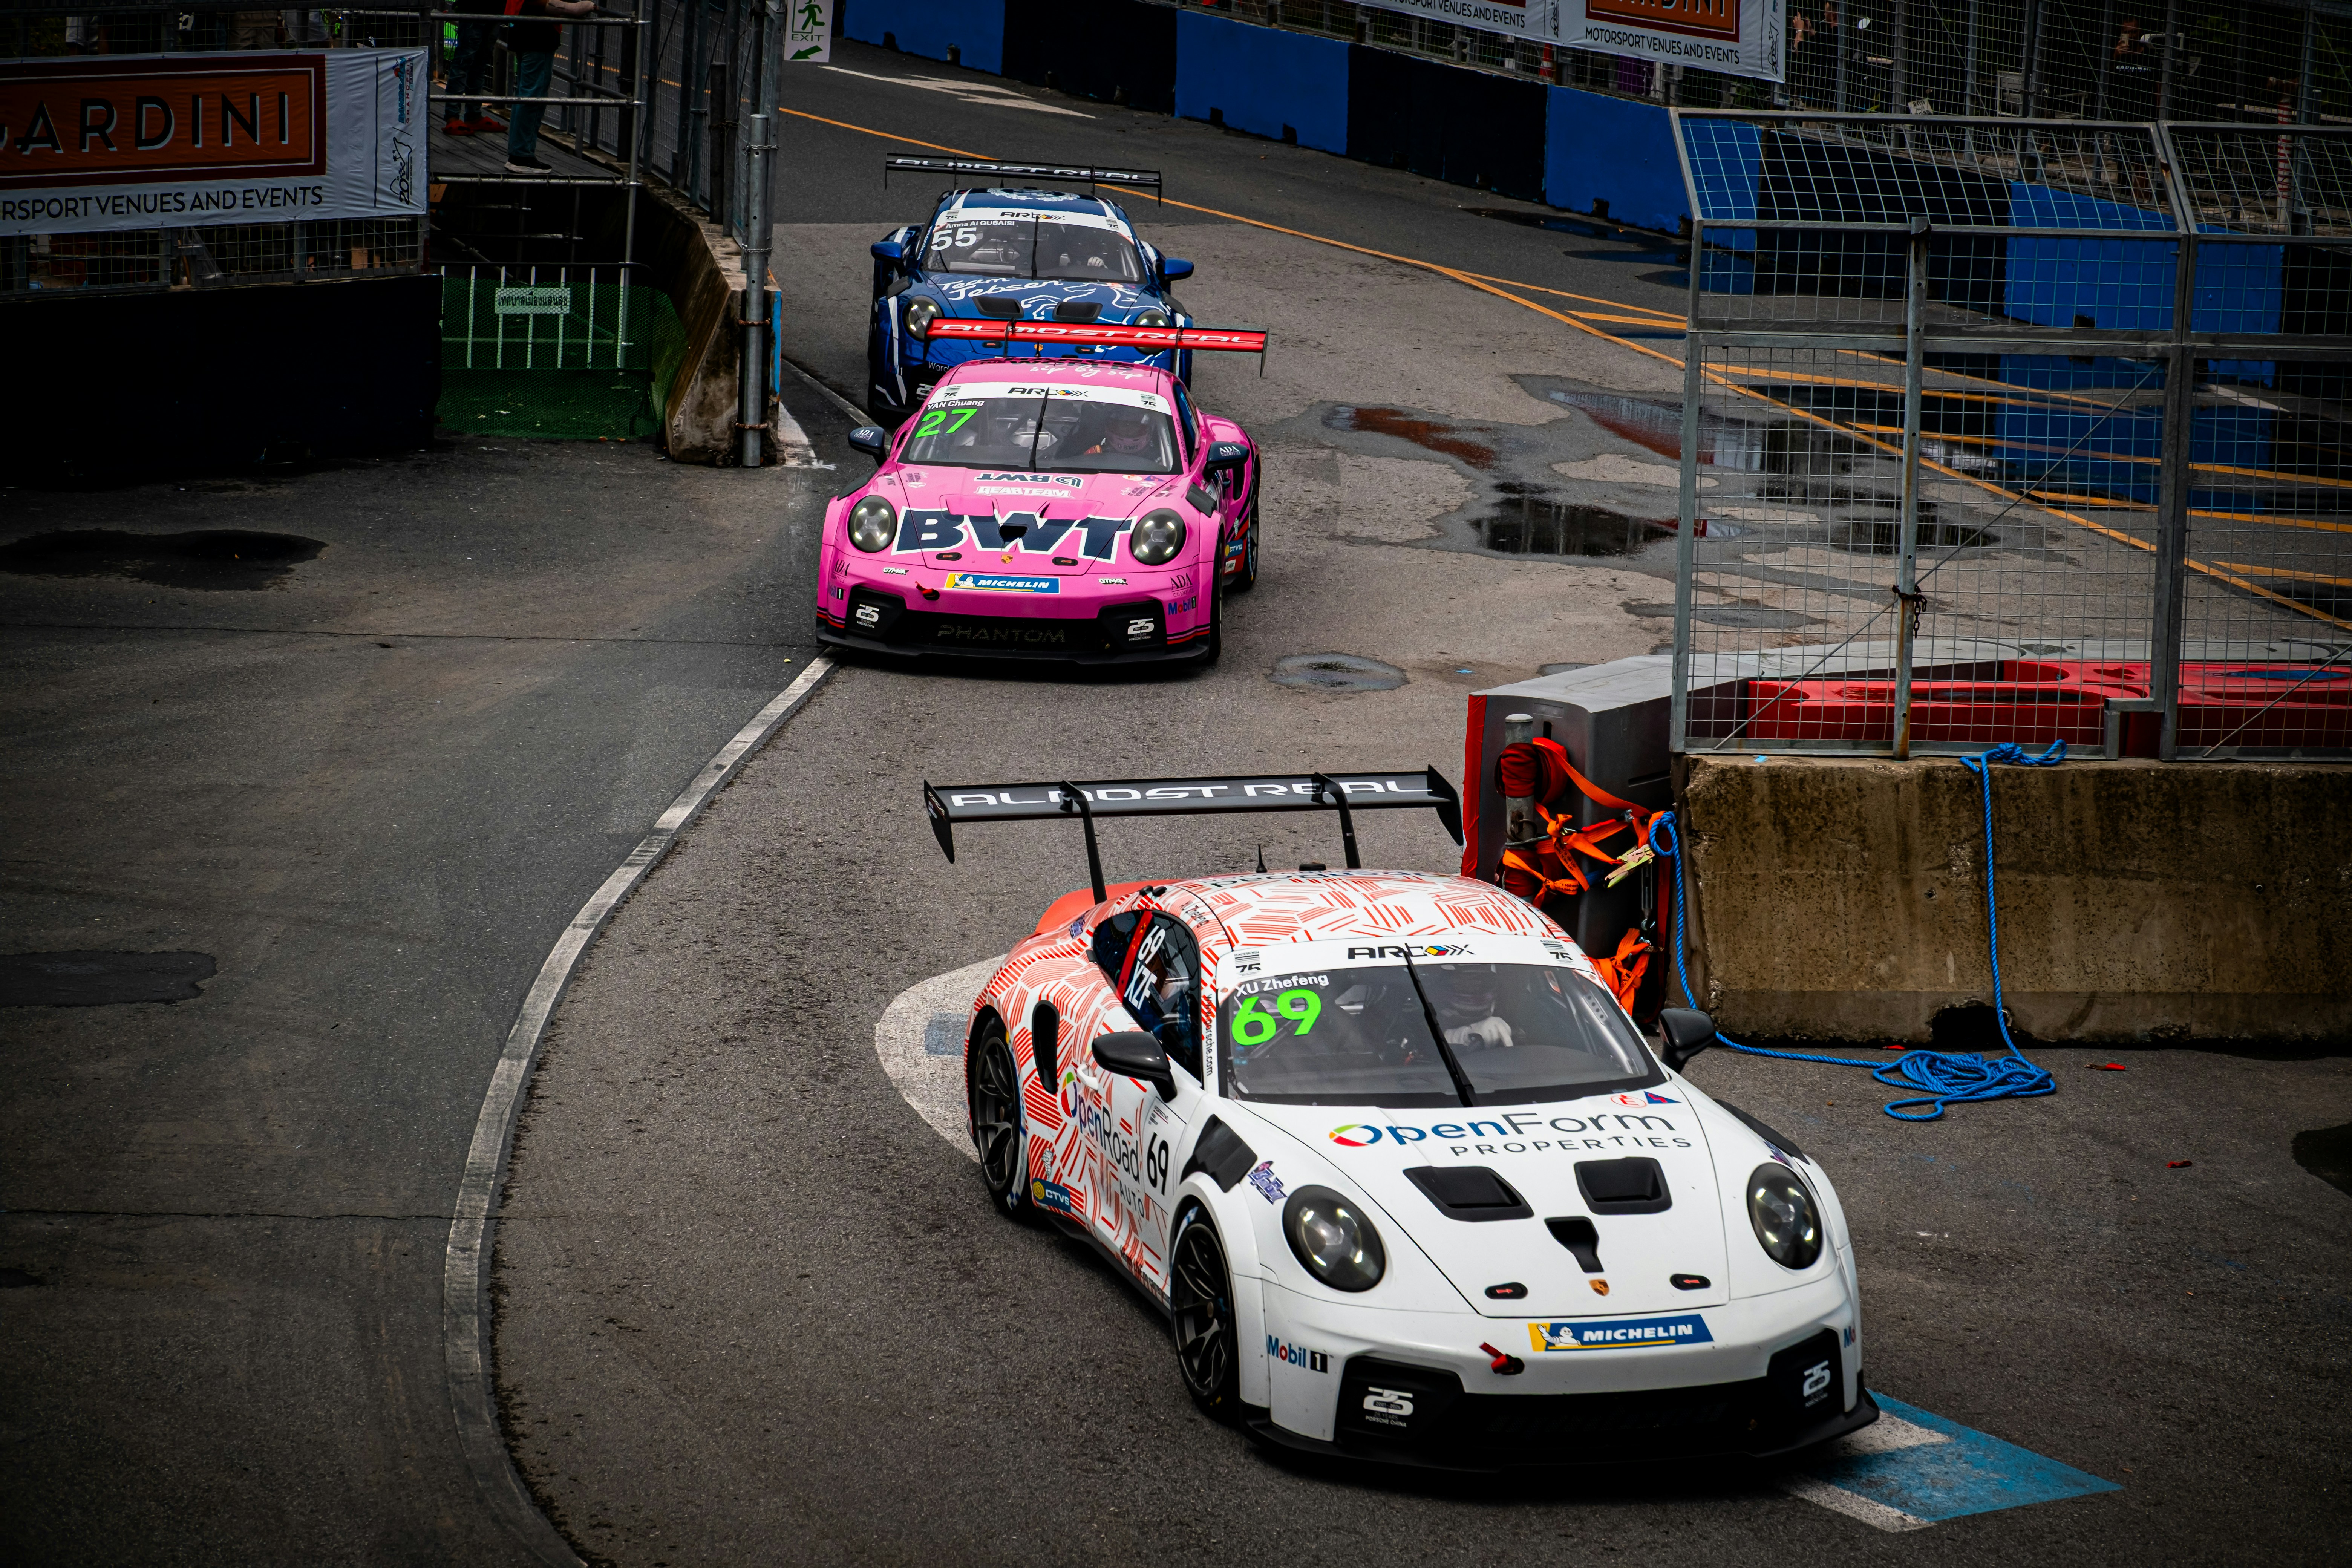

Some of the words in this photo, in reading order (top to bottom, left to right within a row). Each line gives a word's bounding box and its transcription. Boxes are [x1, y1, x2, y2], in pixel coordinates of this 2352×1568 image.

[1473, 8, 1491, 21] AND
[1493, 9, 1525, 28] EVENTS
[1586, 26, 1646, 49] MOTORSPORT
[1646, 37, 1681, 55] VENUES
[1683, 43, 1703, 58] AND
[1705, 46, 1740, 64] EVENTS
[0, 91, 289, 155] ARDINI
[895, 158, 1047, 174] ALMOST
[1053, 168, 1155, 181] REAL
[2, 196, 92, 220] RSPORT
[95, 192, 185, 215] VENUES
[189, 190, 236, 211] AND
[242, 186, 323, 209] EVENTS
[931, 227, 977, 251] 55
[937, 277, 1010, 291] Team
[948, 280, 1064, 300] Jebsen
[940, 324, 1127, 338] ALMOST
[1134, 332, 1258, 344] REAL
[1030, 365, 1066, 374] sip
[1075, 364, 1101, 377] by
[1107, 370, 1144, 380] sip
[928, 401, 946, 410] YAN
[915, 409, 978, 439] 27
[1220, 446, 1240, 454] ADA
[974, 473, 1053, 483] BWT
[976, 486, 1072, 497] GEARTEAM
[891, 506, 1138, 564] BWT
[834, 558, 850, 577] ADA
[977, 579, 1050, 588] MICHELIN
[1170, 572, 1193, 590] ADA
[1168, 598, 1191, 616] Mobil
[937, 624, 1066, 643] PHANTOM
[1127, 617, 1155, 635] 25
[951, 785, 1228, 807] ALMOST
[1245, 781, 1433, 796] REAL
[1138, 925, 1166, 965] 69
[1549, 951, 1574, 960] 75
[1235, 963, 1262, 973] 75
[1124, 961, 1158, 1011] XZF
[1235, 982, 1259, 997] XU
[1261, 974, 1329, 991] Zhefeng
[1231, 989, 1322, 1046] 69
[1206, 993, 1215, 1076] www.porsche.com
[1061, 1071, 1140, 1184] OpenRoad
[1329, 1112, 1675, 1147] OpenForm
[1449, 1136, 1692, 1157] PROPERTIES
[1147, 1132, 1169, 1196] 69
[1045, 1189, 1070, 1206] CTVS
[1119, 1180, 1145, 1218] AUTO
[1583, 1323, 1695, 1343] MICHELIN
[1268, 1335, 1306, 1368] Mobil
[1314, 1353, 1321, 1371] 1
[1803, 1360, 1831, 1397] 25
[1363, 1386, 1414, 1416] 25
